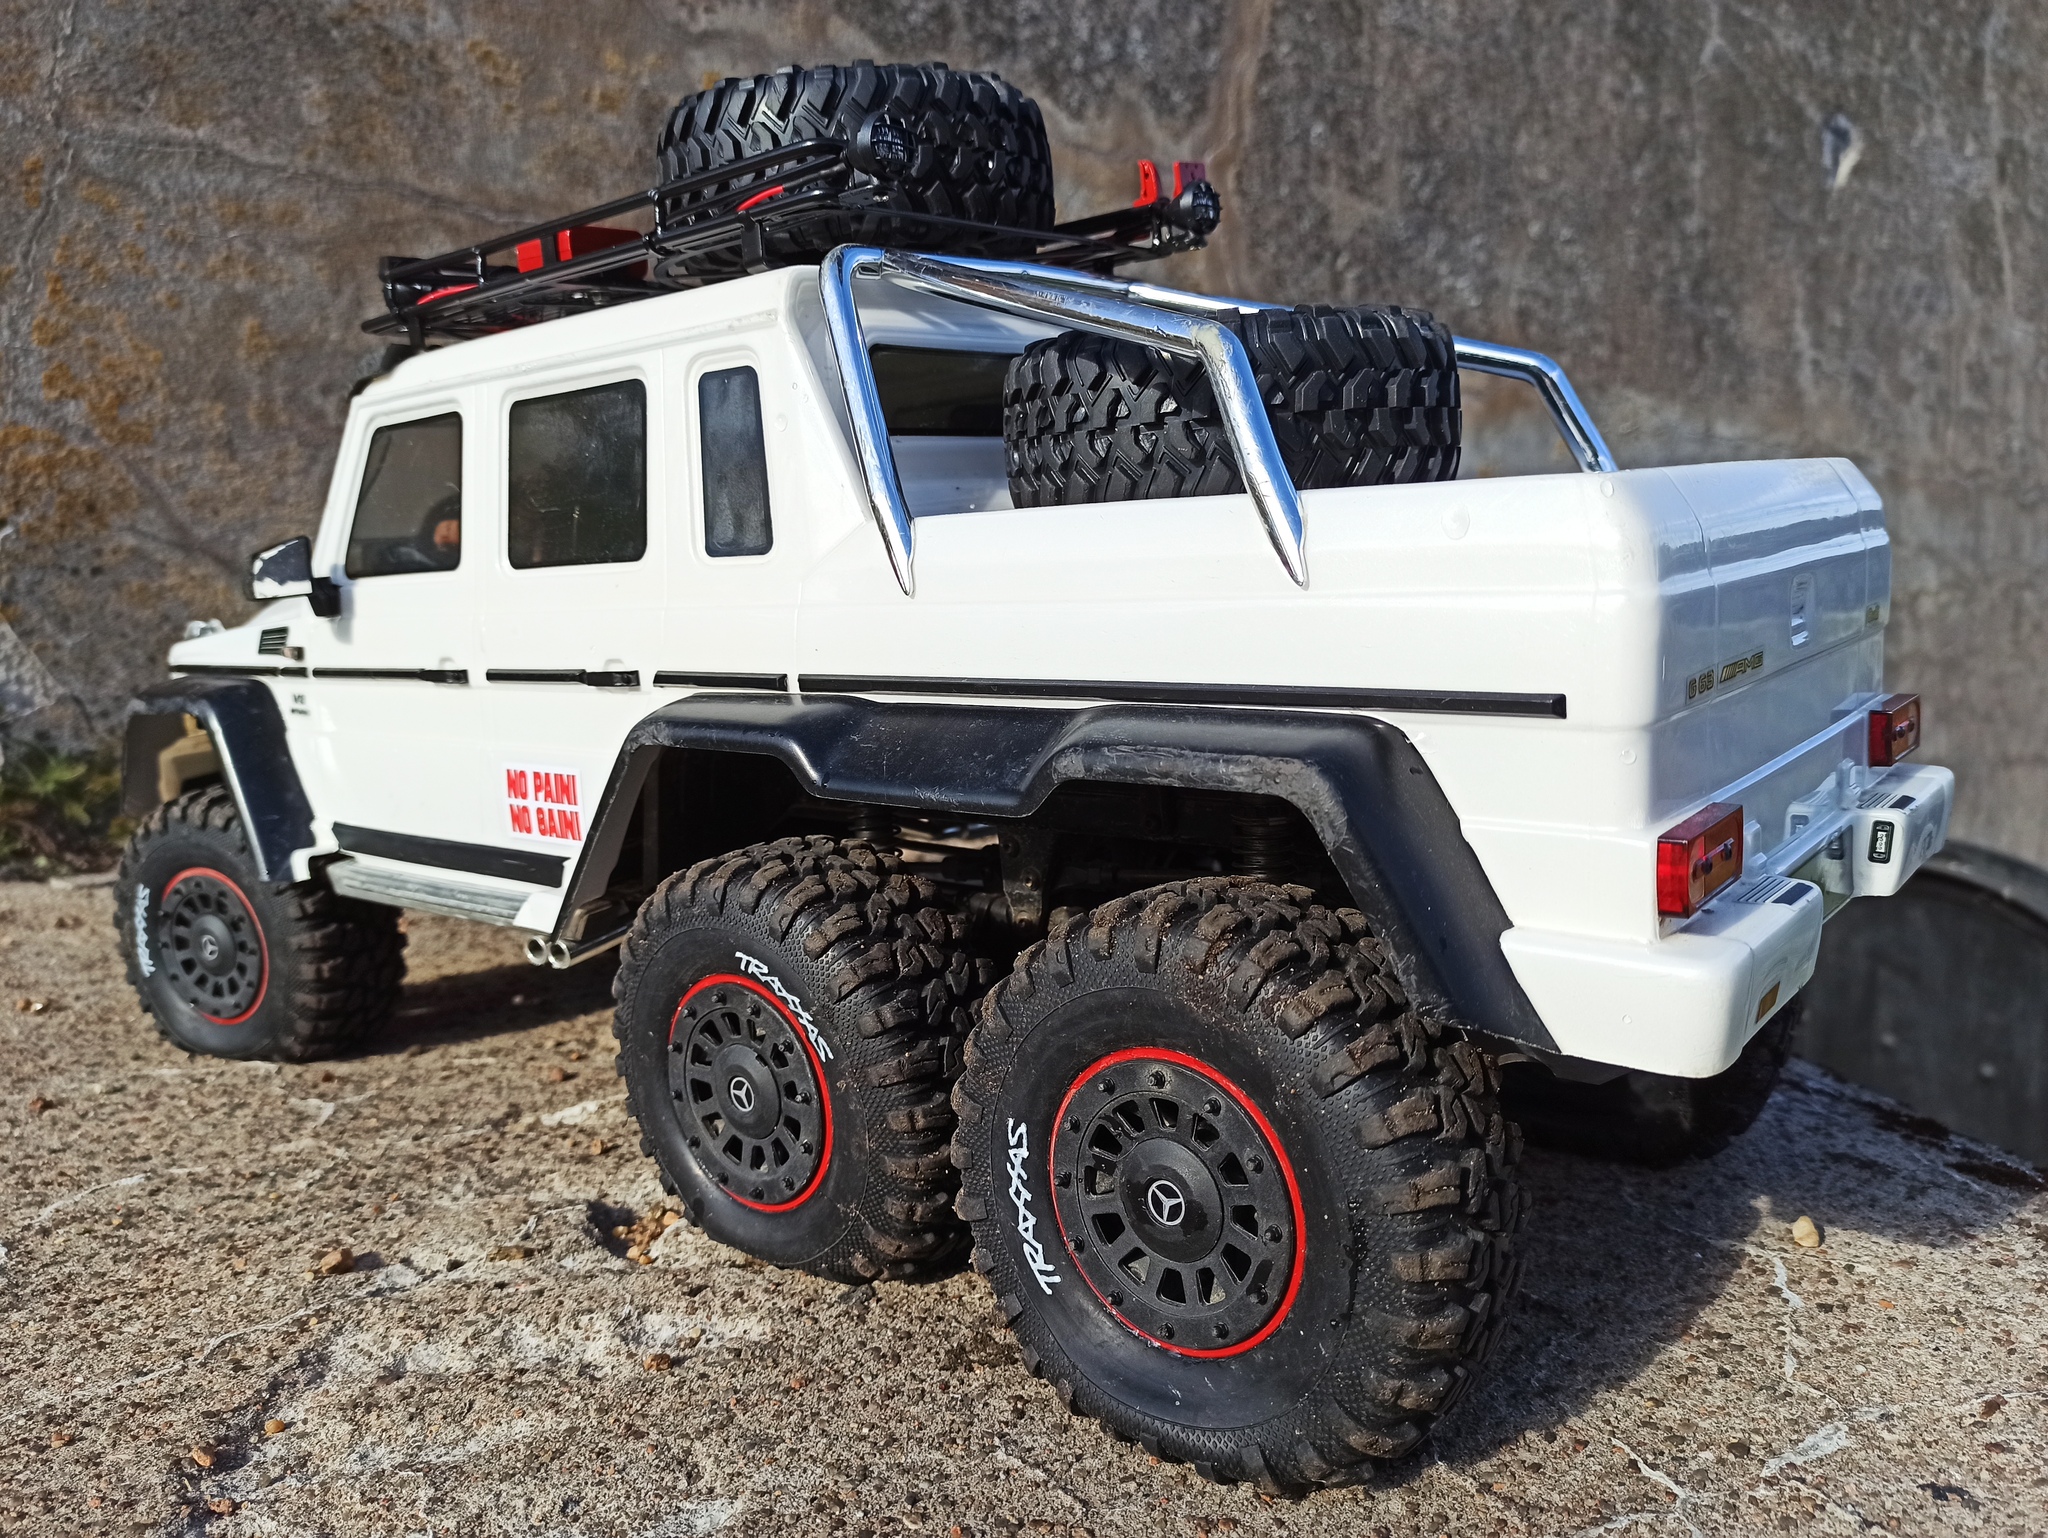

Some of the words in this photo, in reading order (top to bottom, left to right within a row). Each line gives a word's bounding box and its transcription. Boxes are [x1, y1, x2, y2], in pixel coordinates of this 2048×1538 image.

[1688, 677, 1698, 700] G
[1698, 668, 1715, 695] 63
[1733, 650, 1764, 676] AMG
[506, 768, 529, 801] NO
[509, 803, 533, 835] NO
[735, 951, 834, 1063] TRAXXAS
[1006, 1117, 1062, 1295] TRAXXAS
